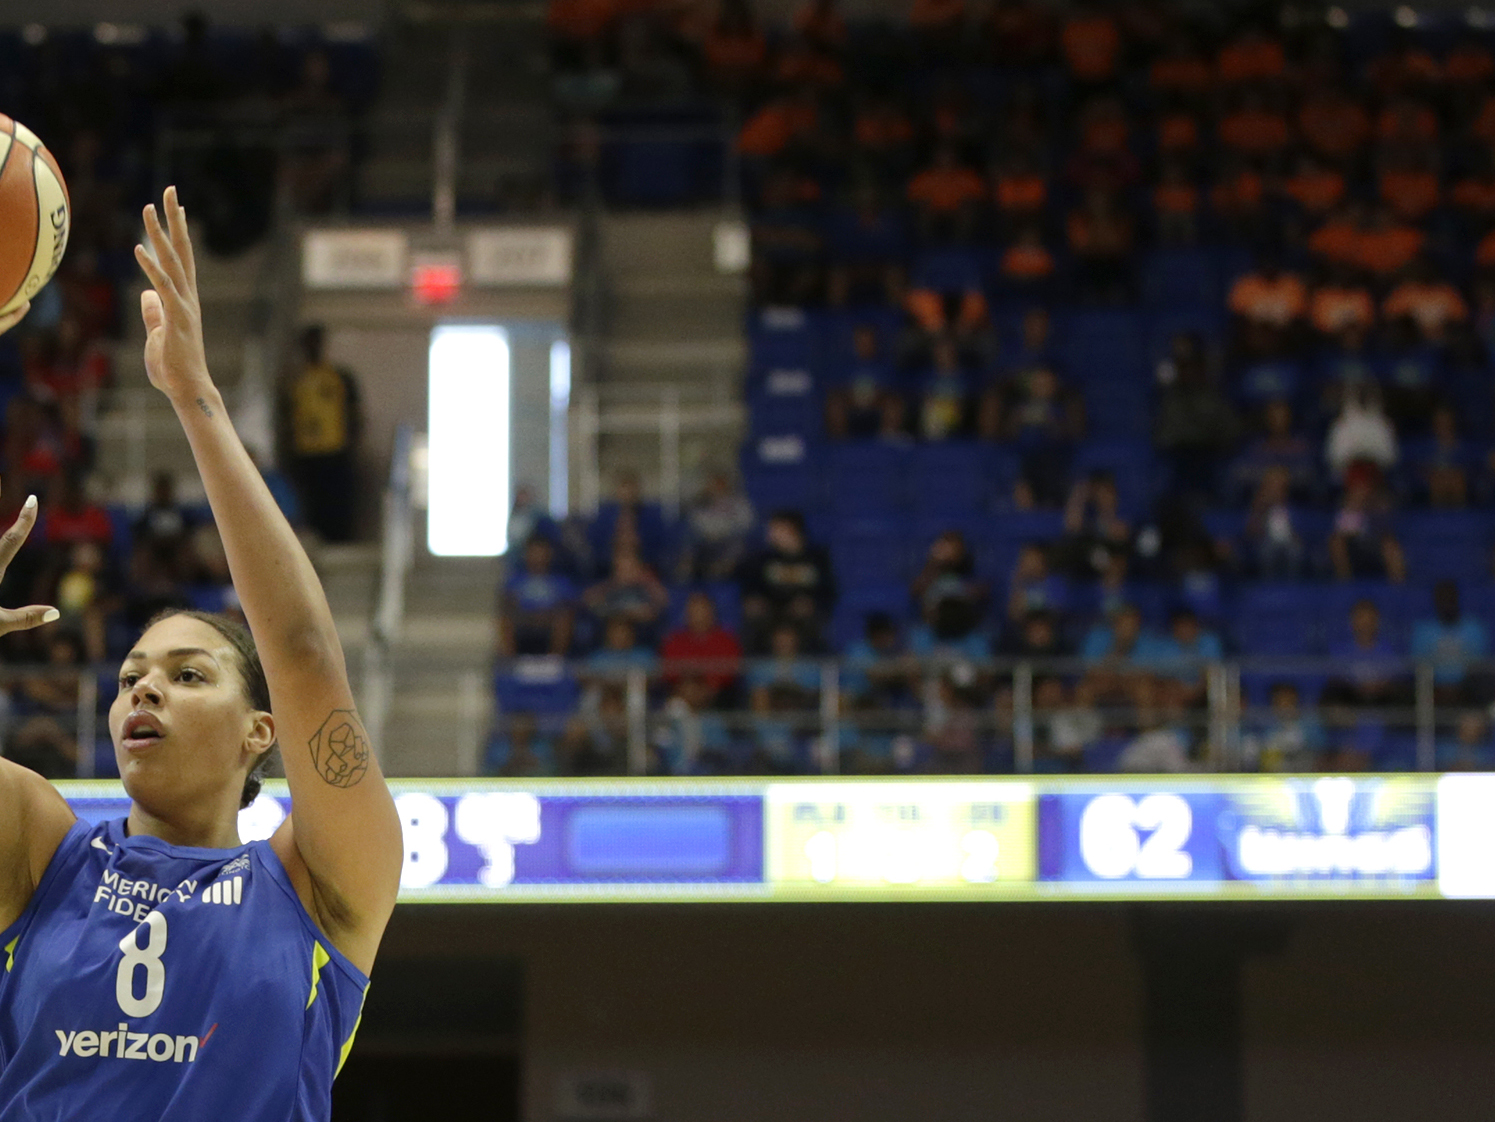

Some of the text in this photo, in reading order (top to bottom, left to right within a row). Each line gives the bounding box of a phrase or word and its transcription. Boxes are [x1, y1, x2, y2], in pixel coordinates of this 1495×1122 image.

[1080, 793, 1193, 879] 62
[116, 910, 168, 1018] 8
[55, 1022, 200, 1063] verizon
